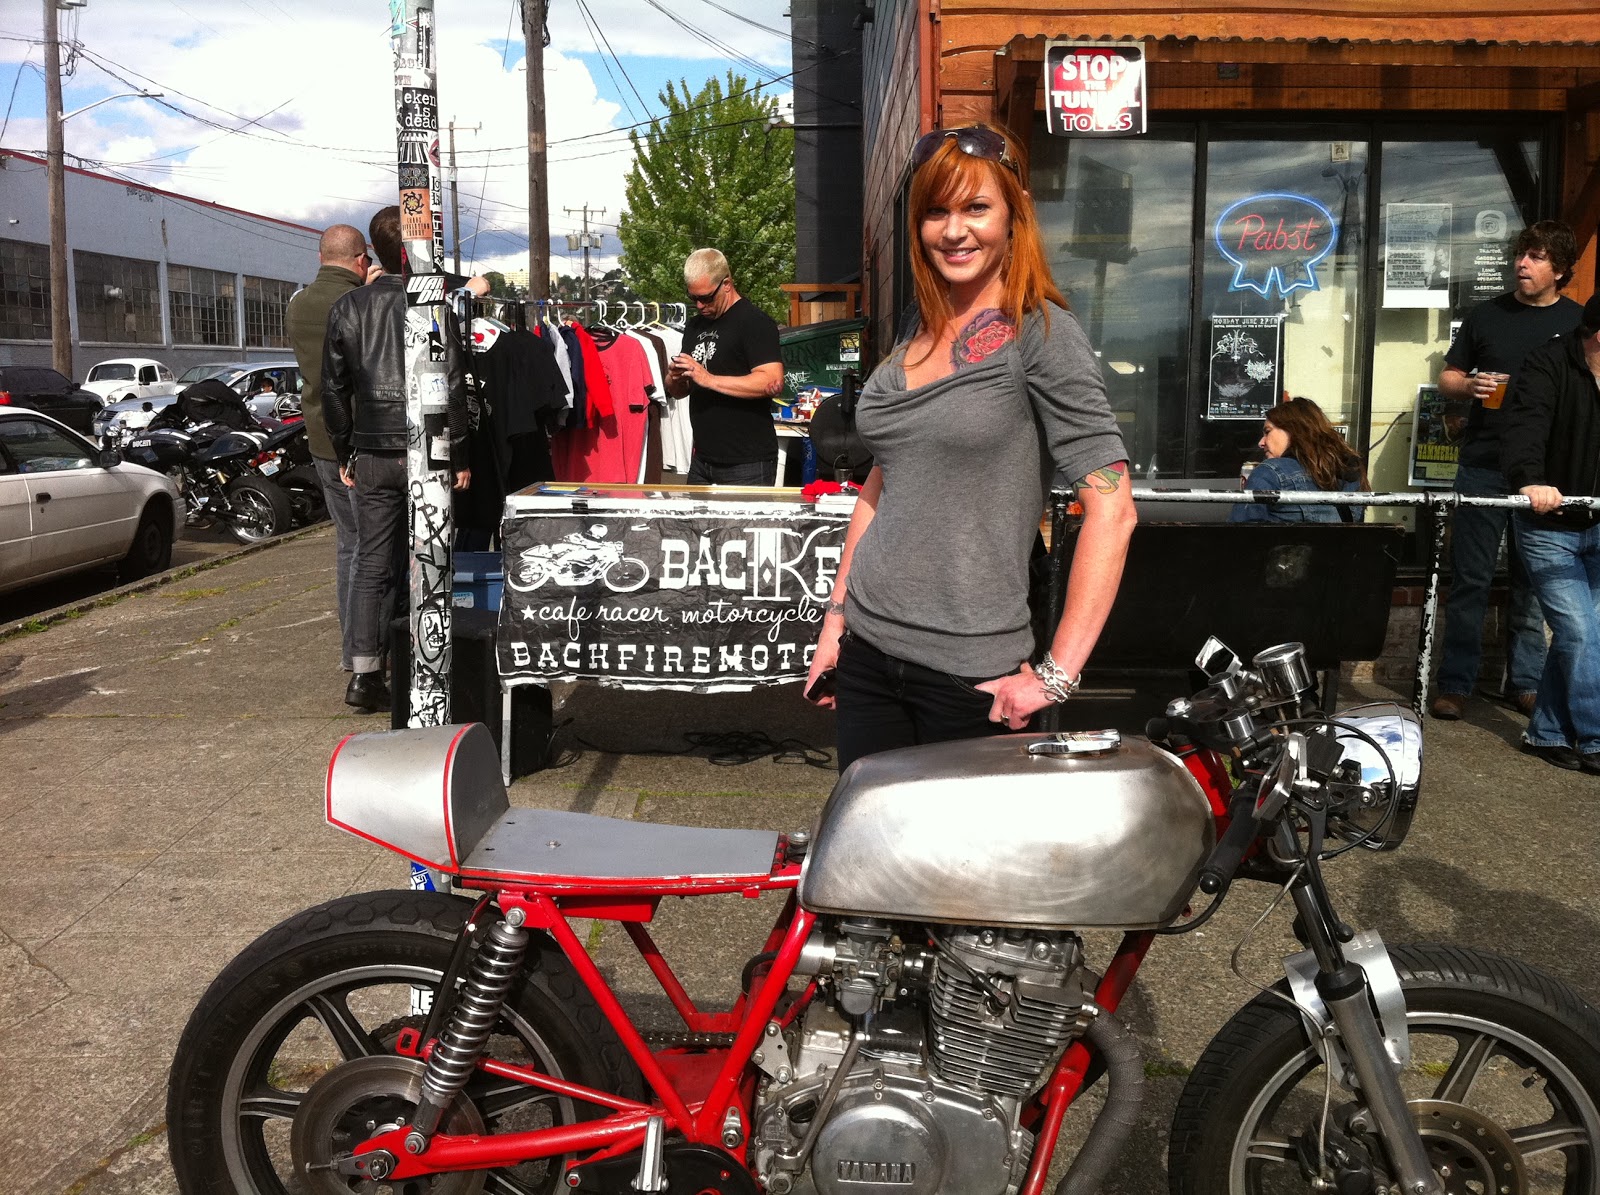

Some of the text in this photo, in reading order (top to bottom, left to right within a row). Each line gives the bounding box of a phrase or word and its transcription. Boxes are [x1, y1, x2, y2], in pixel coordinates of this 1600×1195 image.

[1062, 54, 1127, 81] STOP
[1084, 80, 1106, 91] THE
[1051, 90, 1140, 109] TUNL
[414, 103, 430, 117] is
[405, 113, 437, 129] dead
[1235, 213, 1320, 250] Pabst
[132, 439, 151, 448] DUCATI
[659, 525, 846, 602] BACKF
[539, 594, 823, 643] cafe racer motorcycle
[839, 1161, 913, 1183] YAMAHA
